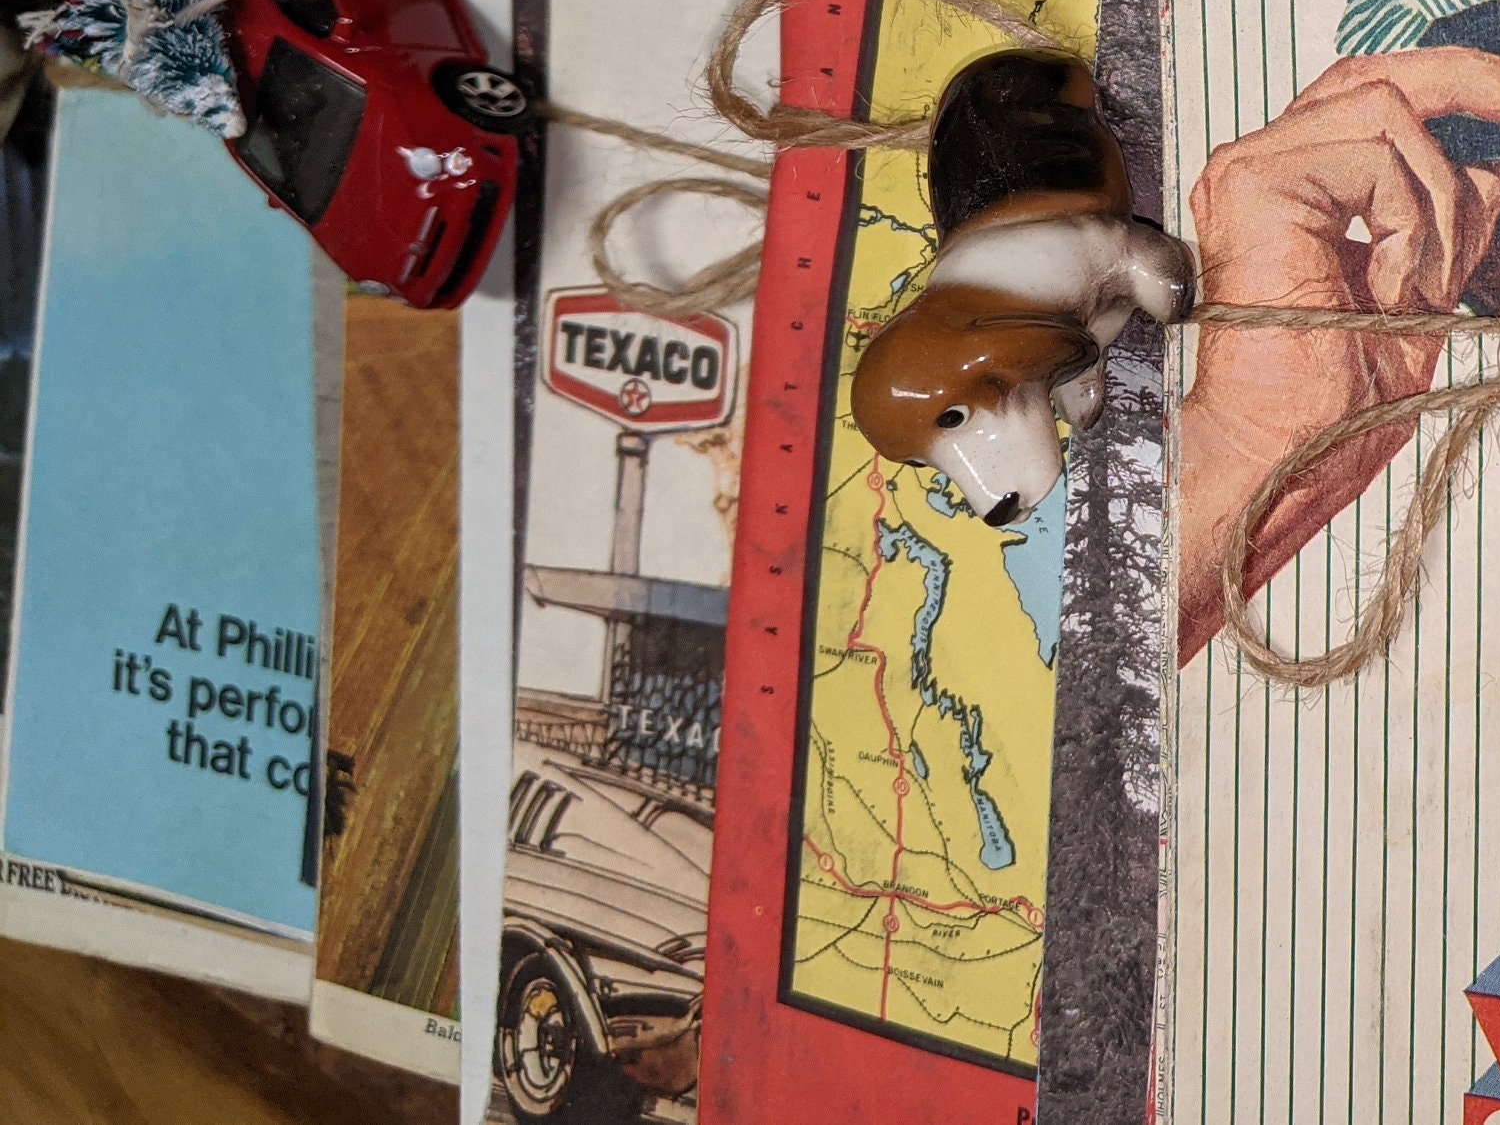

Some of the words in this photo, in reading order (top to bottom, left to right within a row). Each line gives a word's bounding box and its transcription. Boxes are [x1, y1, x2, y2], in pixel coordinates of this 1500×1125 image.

[560, 320, 720, 391] TEXACO
[155, 602, 203, 651] At
[847, 651, 878, 666] RIVER
[113, 647, 173, 702] it's
[167, 718, 251, 780] that
[858, 750, 899, 769] DAUPHIN
[7, 859, 56, 892] FREE
[883, 878, 930, 899] BRANDON
[980, 893, 1021, 912] PORTAGE
[931, 928, 962, 939] RIVER
[888, 965, 945, 989] BOISSEVAIN
